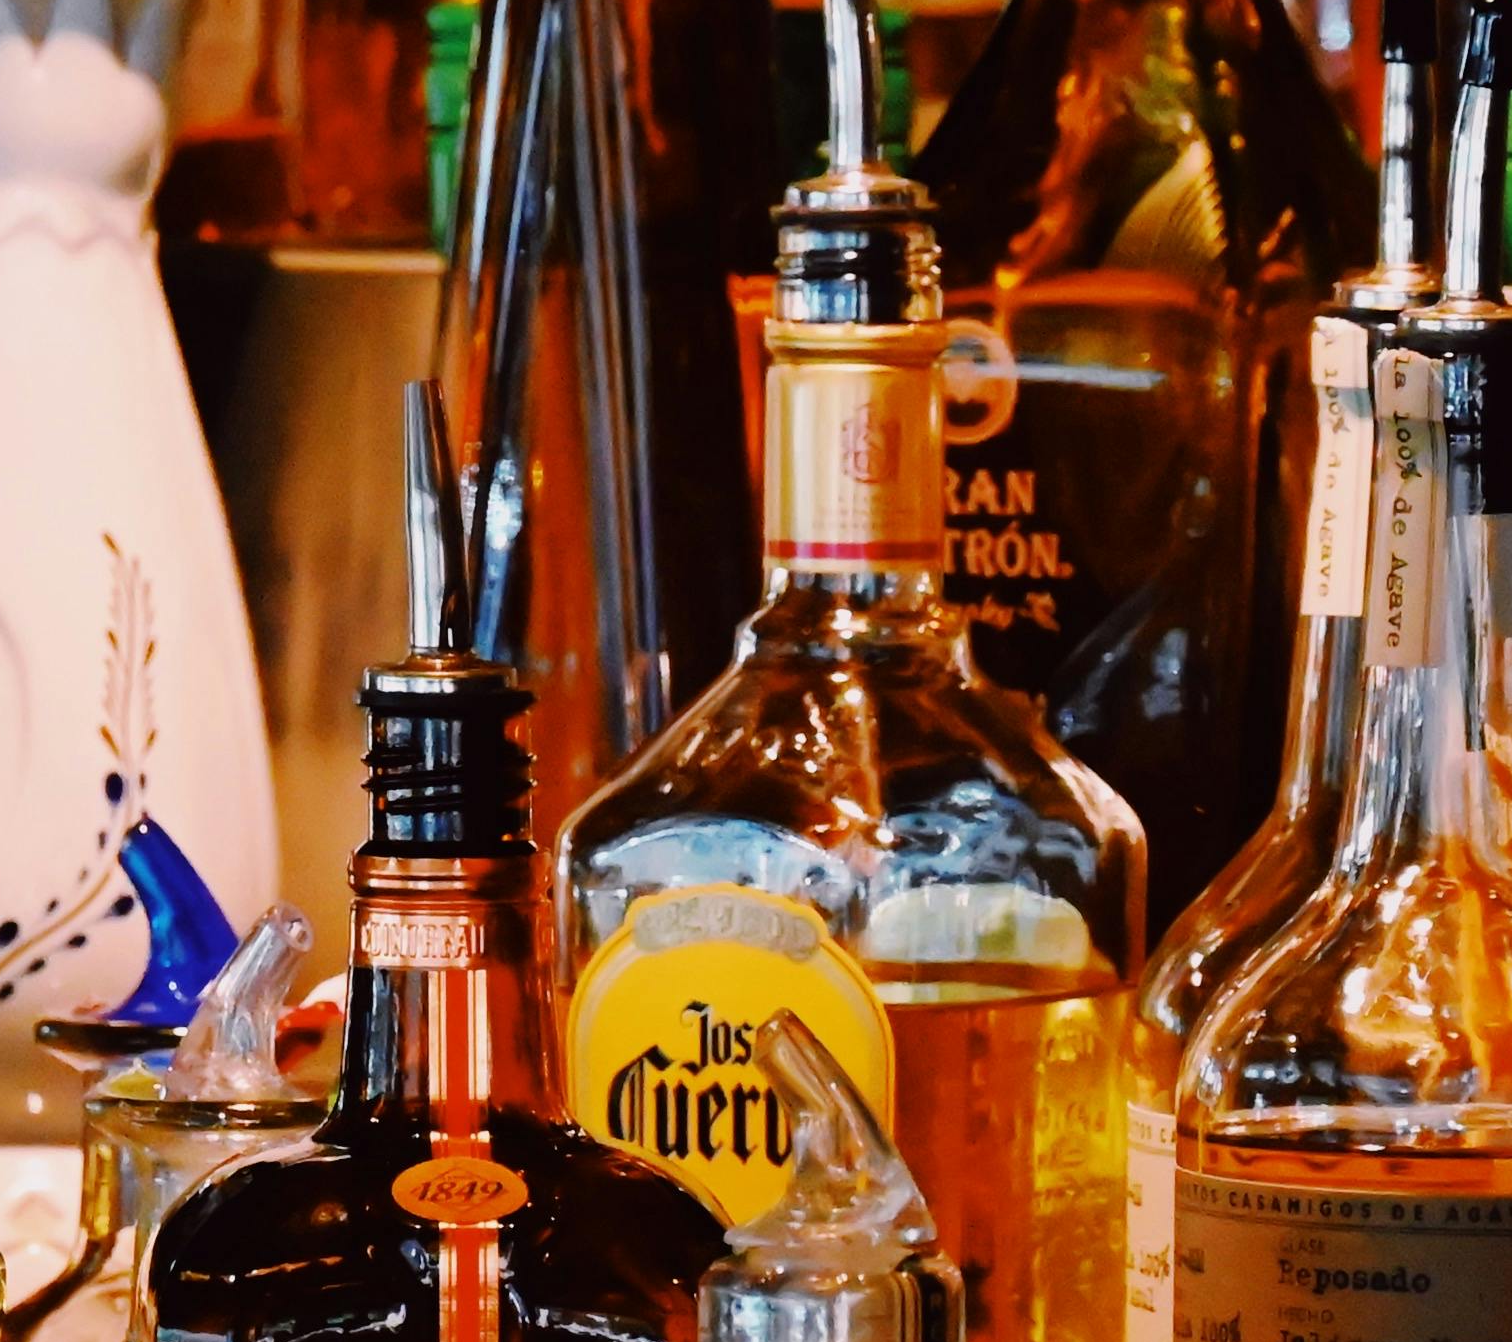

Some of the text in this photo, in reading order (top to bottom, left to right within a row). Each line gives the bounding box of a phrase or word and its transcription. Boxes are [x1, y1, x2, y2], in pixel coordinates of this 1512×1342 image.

[1393, 412, 1422, 480] 100%
[943, 470, 1036, 515] RAN
[1393, 495, 1412, 535] de
[1319, 508, 1333, 598] Agave
[1387, 557, 1408, 648] Agave
[681, 1000, 755, 1076] Jos
[606, 1044, 793, 1167] Cuerv
[416, 1178, 504, 1203] 1849
[1228, 1190, 1372, 1219] CASAMIGOS
[1392, 1204, 1424, 1222] DE
[1278, 1259, 1431, 1294] Reposado
